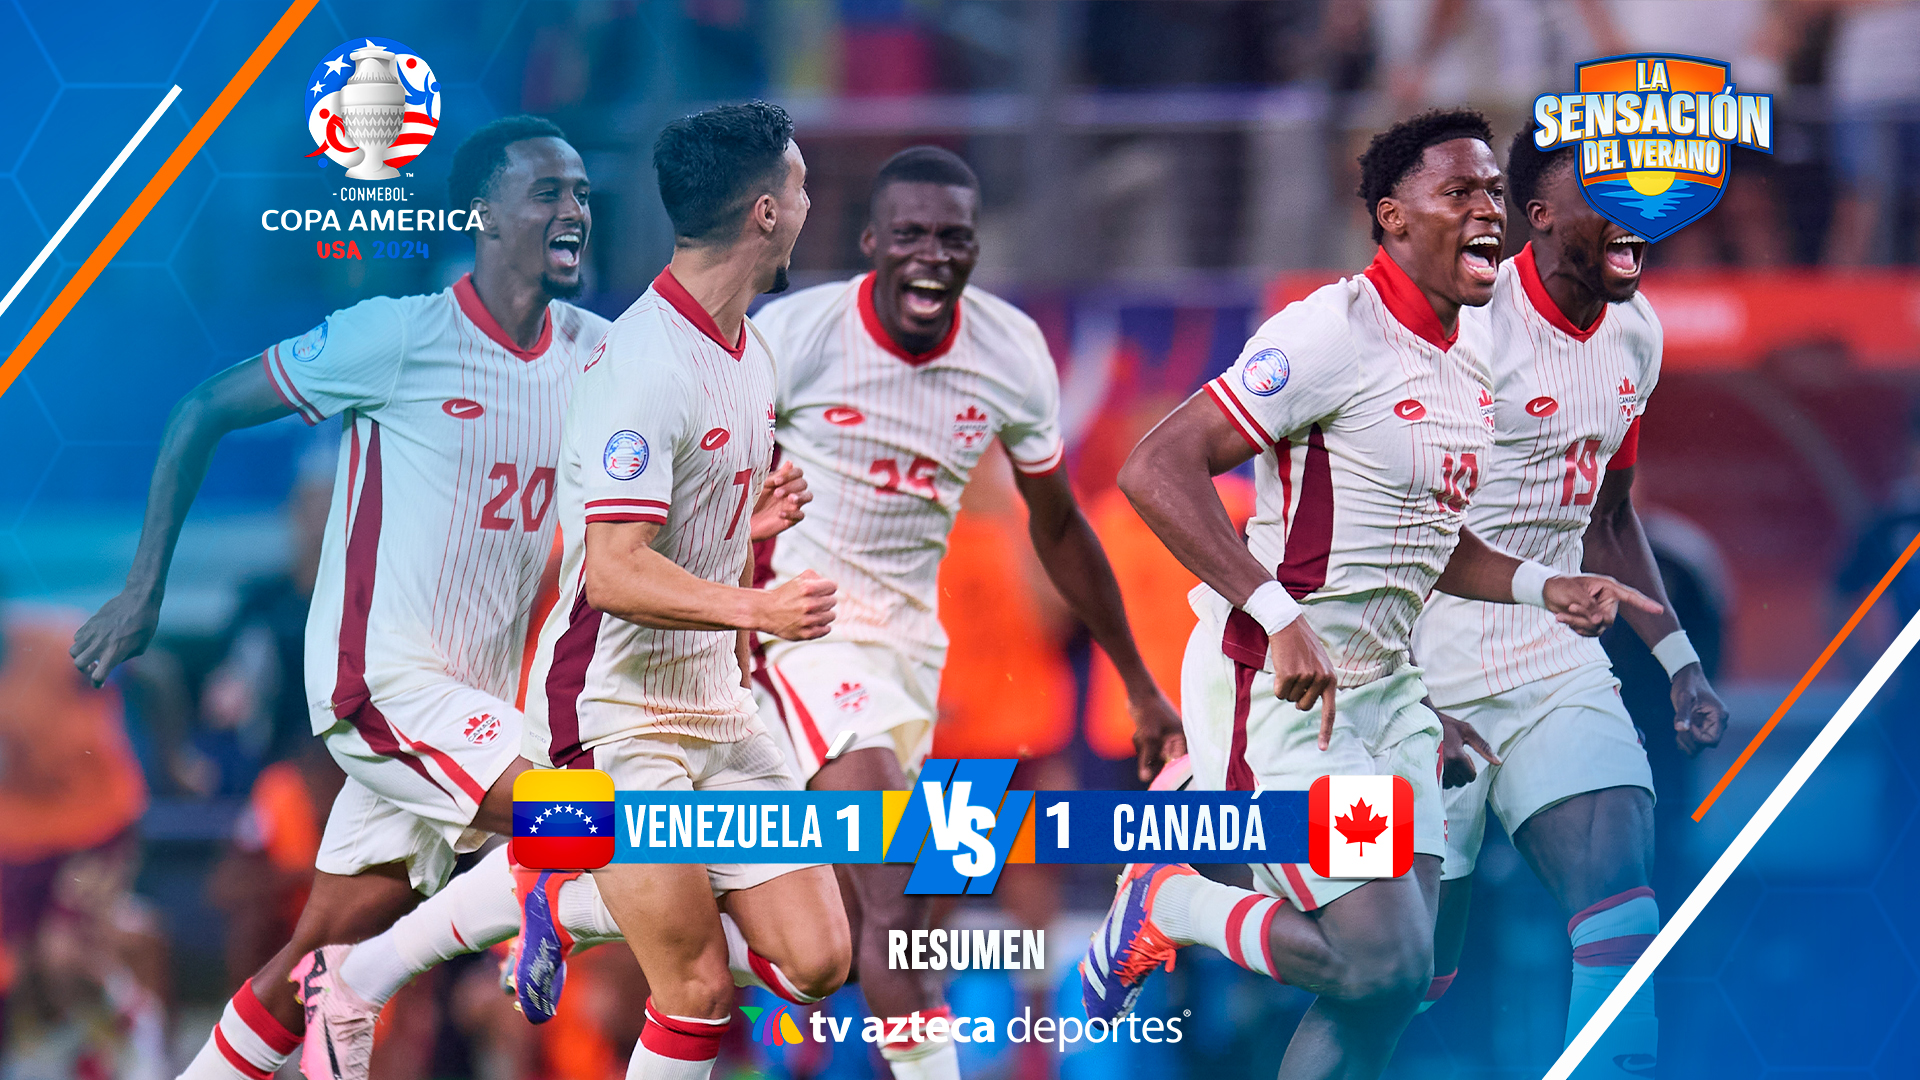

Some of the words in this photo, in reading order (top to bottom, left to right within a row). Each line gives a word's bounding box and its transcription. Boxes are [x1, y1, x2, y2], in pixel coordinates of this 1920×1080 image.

[480, 462, 556, 532] 20
[724, 468, 752, 541] 7
[1436, 452, 1479, 513] 10
[1560, 439, 1602, 507] 19
[467, 716, 497, 743] CANADA
